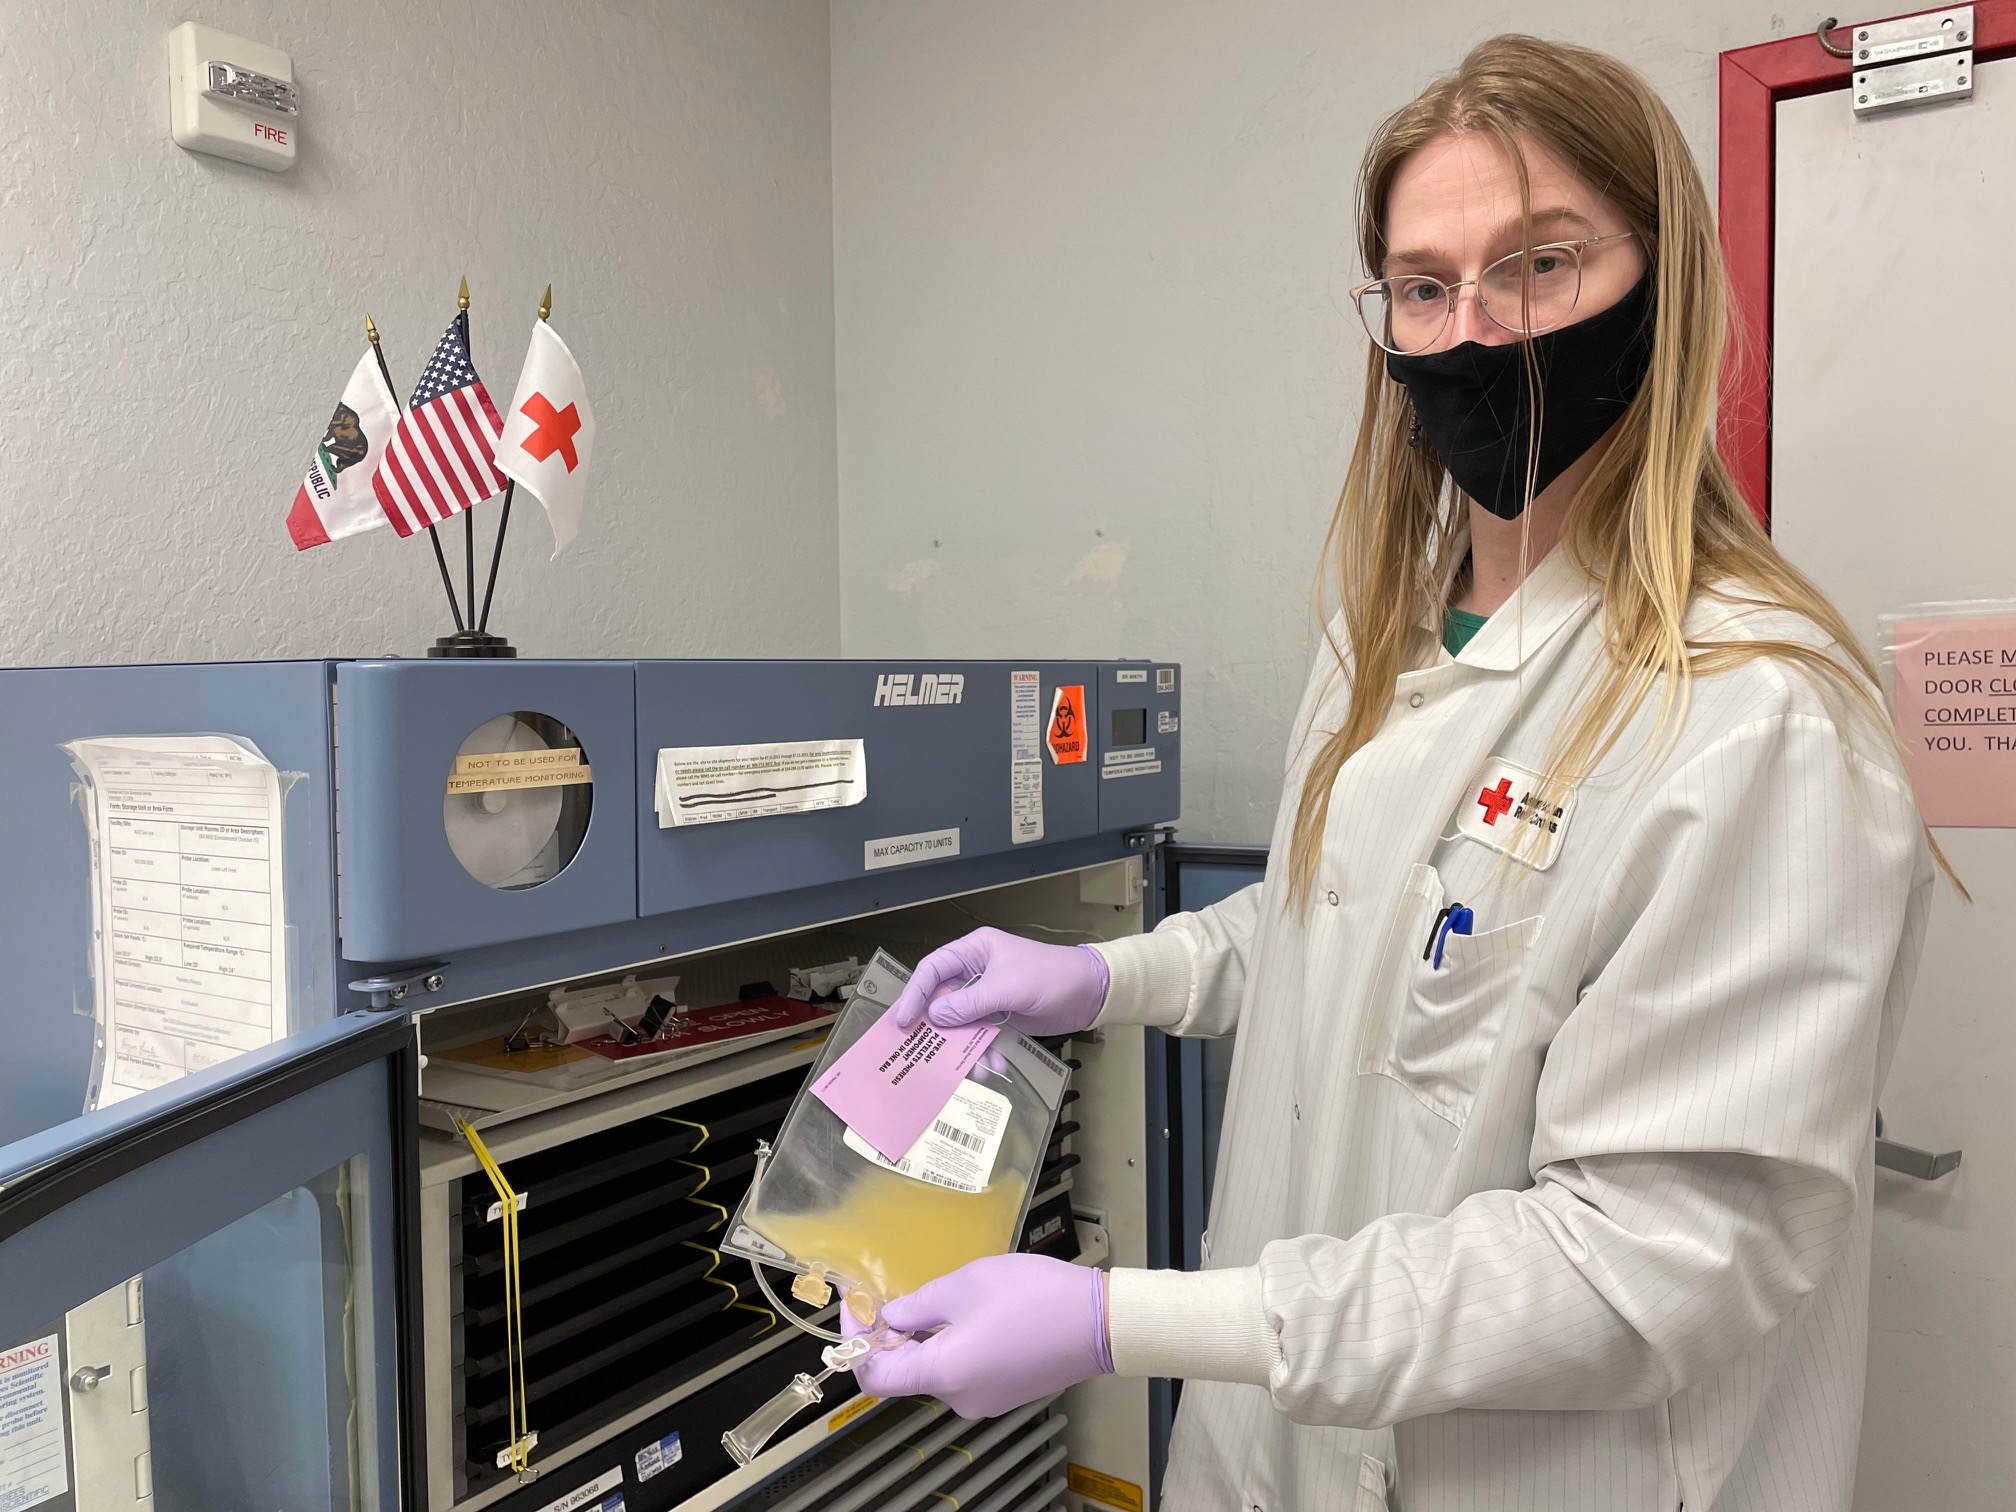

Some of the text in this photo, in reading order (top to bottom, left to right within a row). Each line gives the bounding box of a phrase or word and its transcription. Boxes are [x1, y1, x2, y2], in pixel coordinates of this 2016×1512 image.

[255, 123, 287, 145] FIRE
[1925, 650, 1994, 665] PLEASE
[874, 674, 964, 706] HELMER
[1925, 678, 2016, 694] DOOR CL
[1925, 736, 2016, 751] YOU. TH
[469, 761, 491, 769] NOT
[530, 756, 554, 764] USED
[558, 754, 577, 762] FOR
[449, 772, 584, 788] TEMPERATURE MONITORING
[122, 804, 137, 812] Storage
[201, 945, 225, 954] Temperature
[226, 947, 238, 956] Range
[698, 1011, 790, 1032] SLOWLY
[708, 1007, 770, 1021] OPEN
[879, 1021, 927, 1073] SHIPPED IN ONE BAG
[902, 1027, 933, 1061] COMPONENT
[923, 1037, 946, 1063] FIVE-DAY
[117, 1054, 129, 1063] Second
[130, 1057, 141, 1065] Person
[891, 1032, 940, 1086] PLATELETS PHERESIS
[1029, 1216, 1061, 1245] HELMER
[12, 1362, 49, 1380] monitored
[10, 1373, 44, 1388] Scientific
[19, 1390, 45, 1403] system.
[5, 1401, 43, 1418] disconnect
[2, 1407, 48, 1430] probe before
[12, 1424, 25, 1433] this
[27, 1417, 43, 1427] unit.
[570, 1484, 599, 1505] 963068
